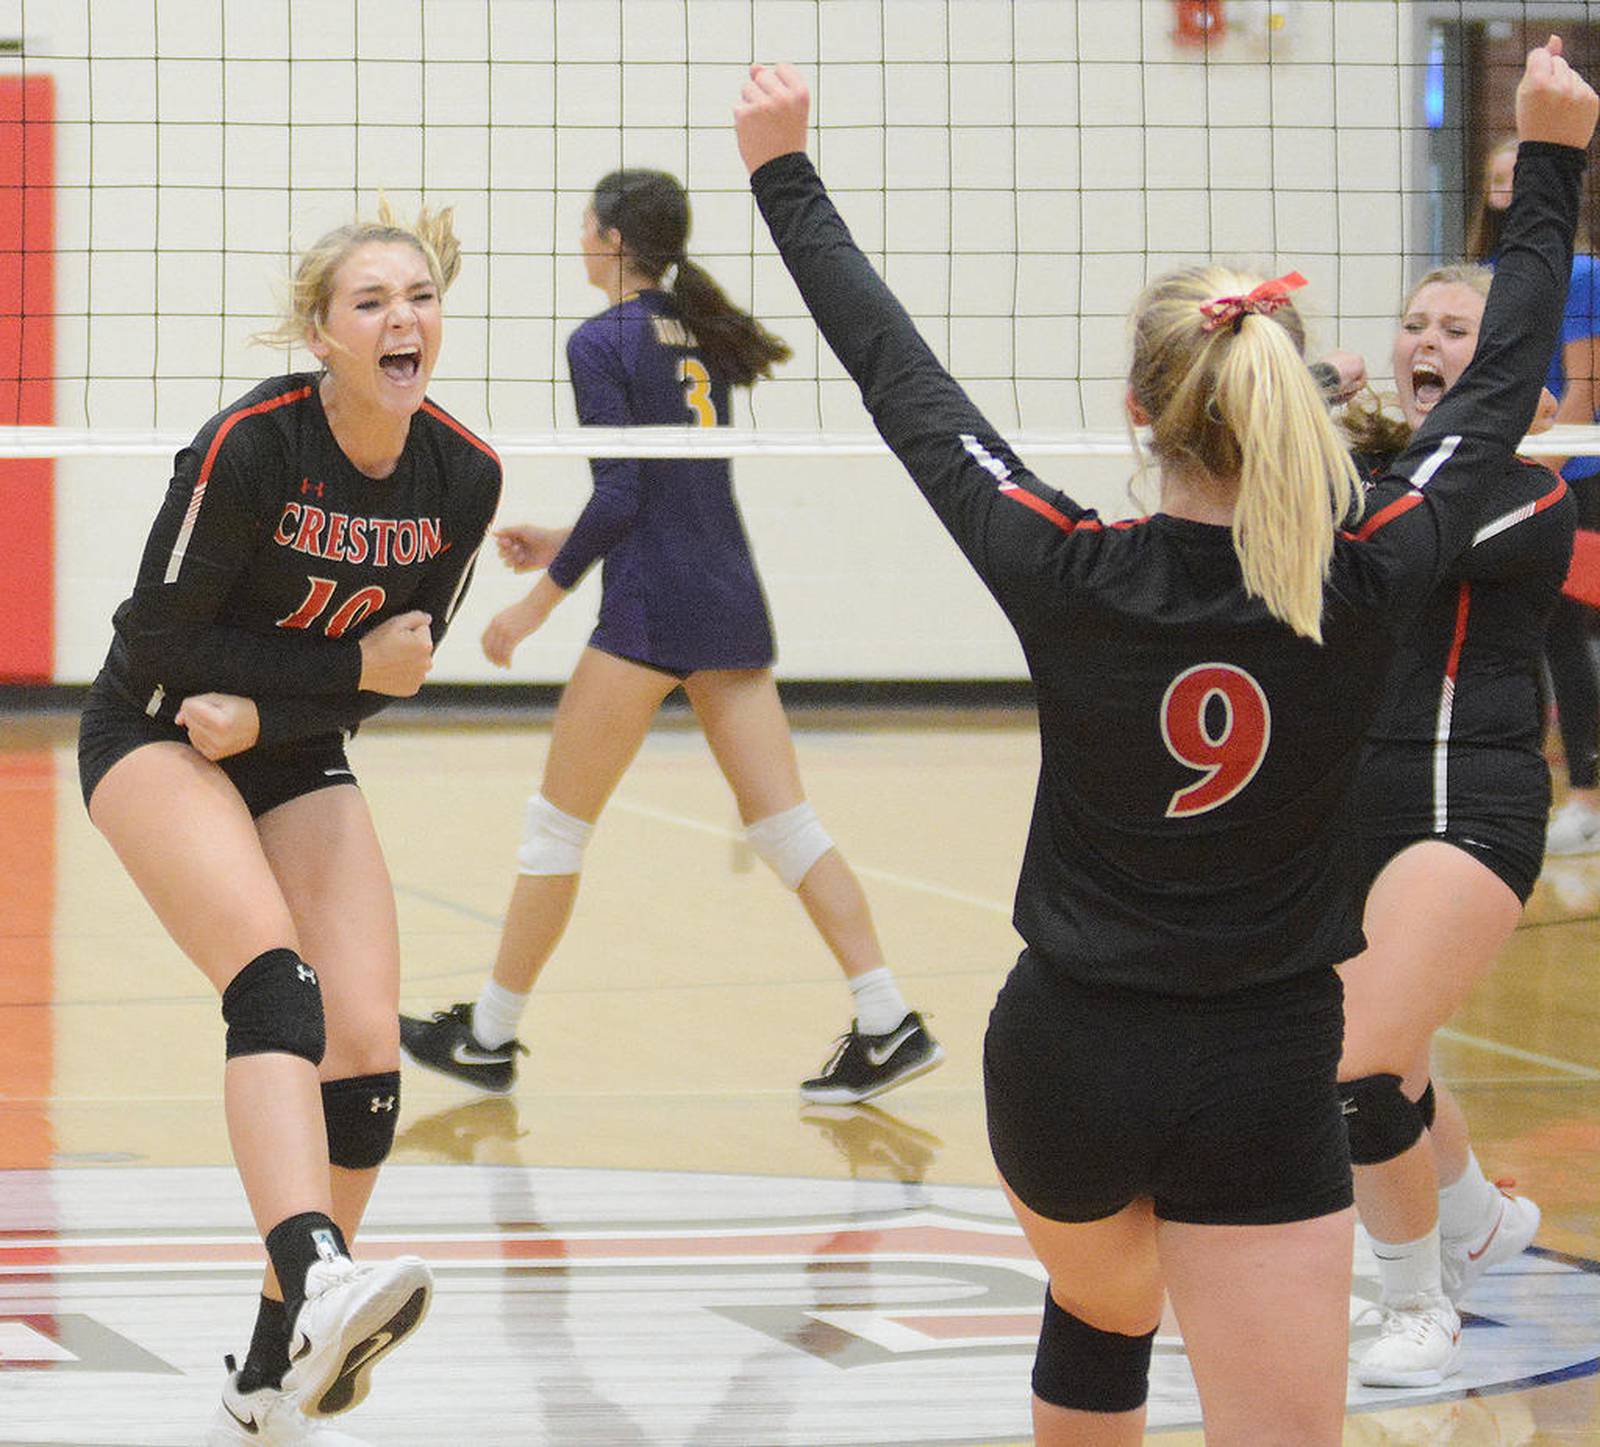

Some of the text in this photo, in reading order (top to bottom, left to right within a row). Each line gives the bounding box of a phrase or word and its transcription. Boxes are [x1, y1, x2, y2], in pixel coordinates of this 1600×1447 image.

[677, 357, 718, 428] 3
[273, 501, 442, 567] CRESTON
[275, 576, 386, 640] 10
[1160, 662, 1271, 818] 9
